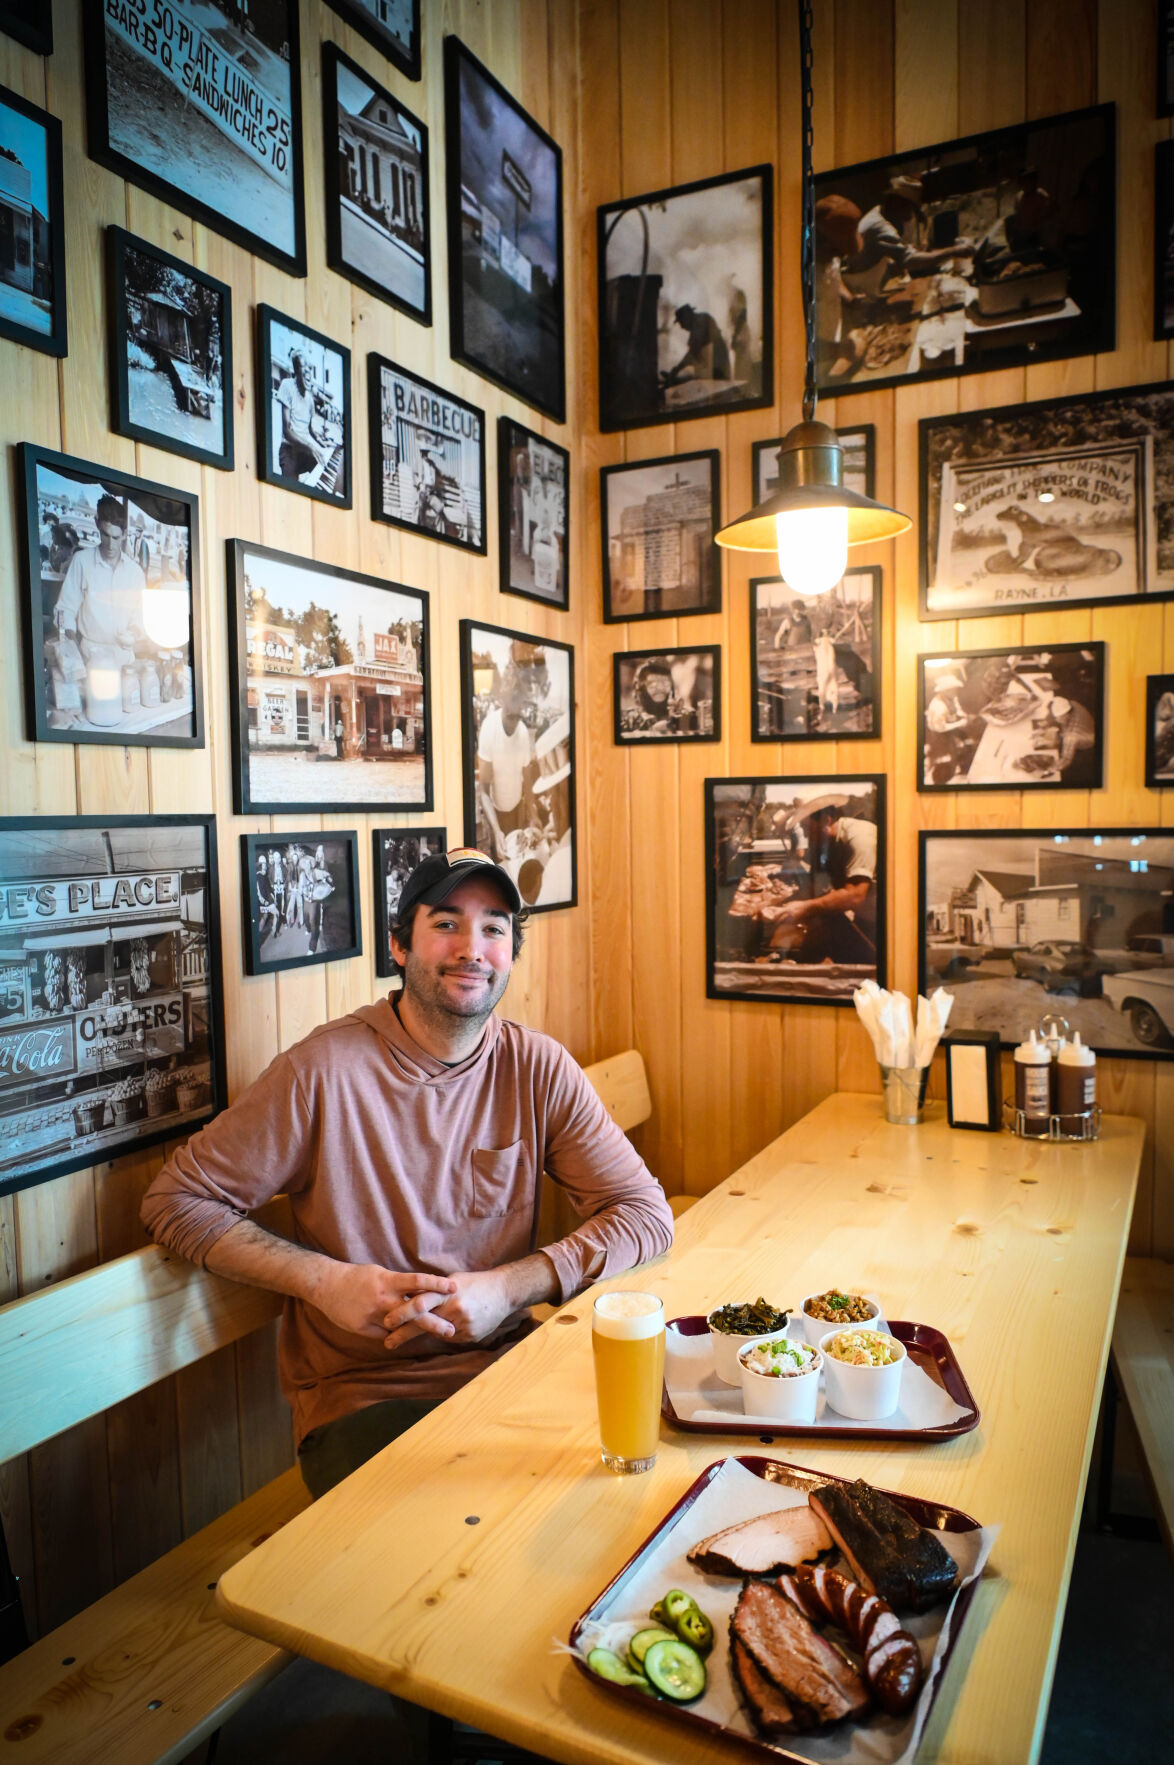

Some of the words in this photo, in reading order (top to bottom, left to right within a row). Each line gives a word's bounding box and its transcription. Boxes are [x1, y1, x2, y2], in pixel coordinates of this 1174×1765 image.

[223, 65, 263, 125] LUNCH
[394, 382, 480, 442] BARBECUE
[1058, 460, 1132, 484] COMPANY
[1094, 479, 1132, 505] FROGS
[0, 885, 57, 920] E'S
